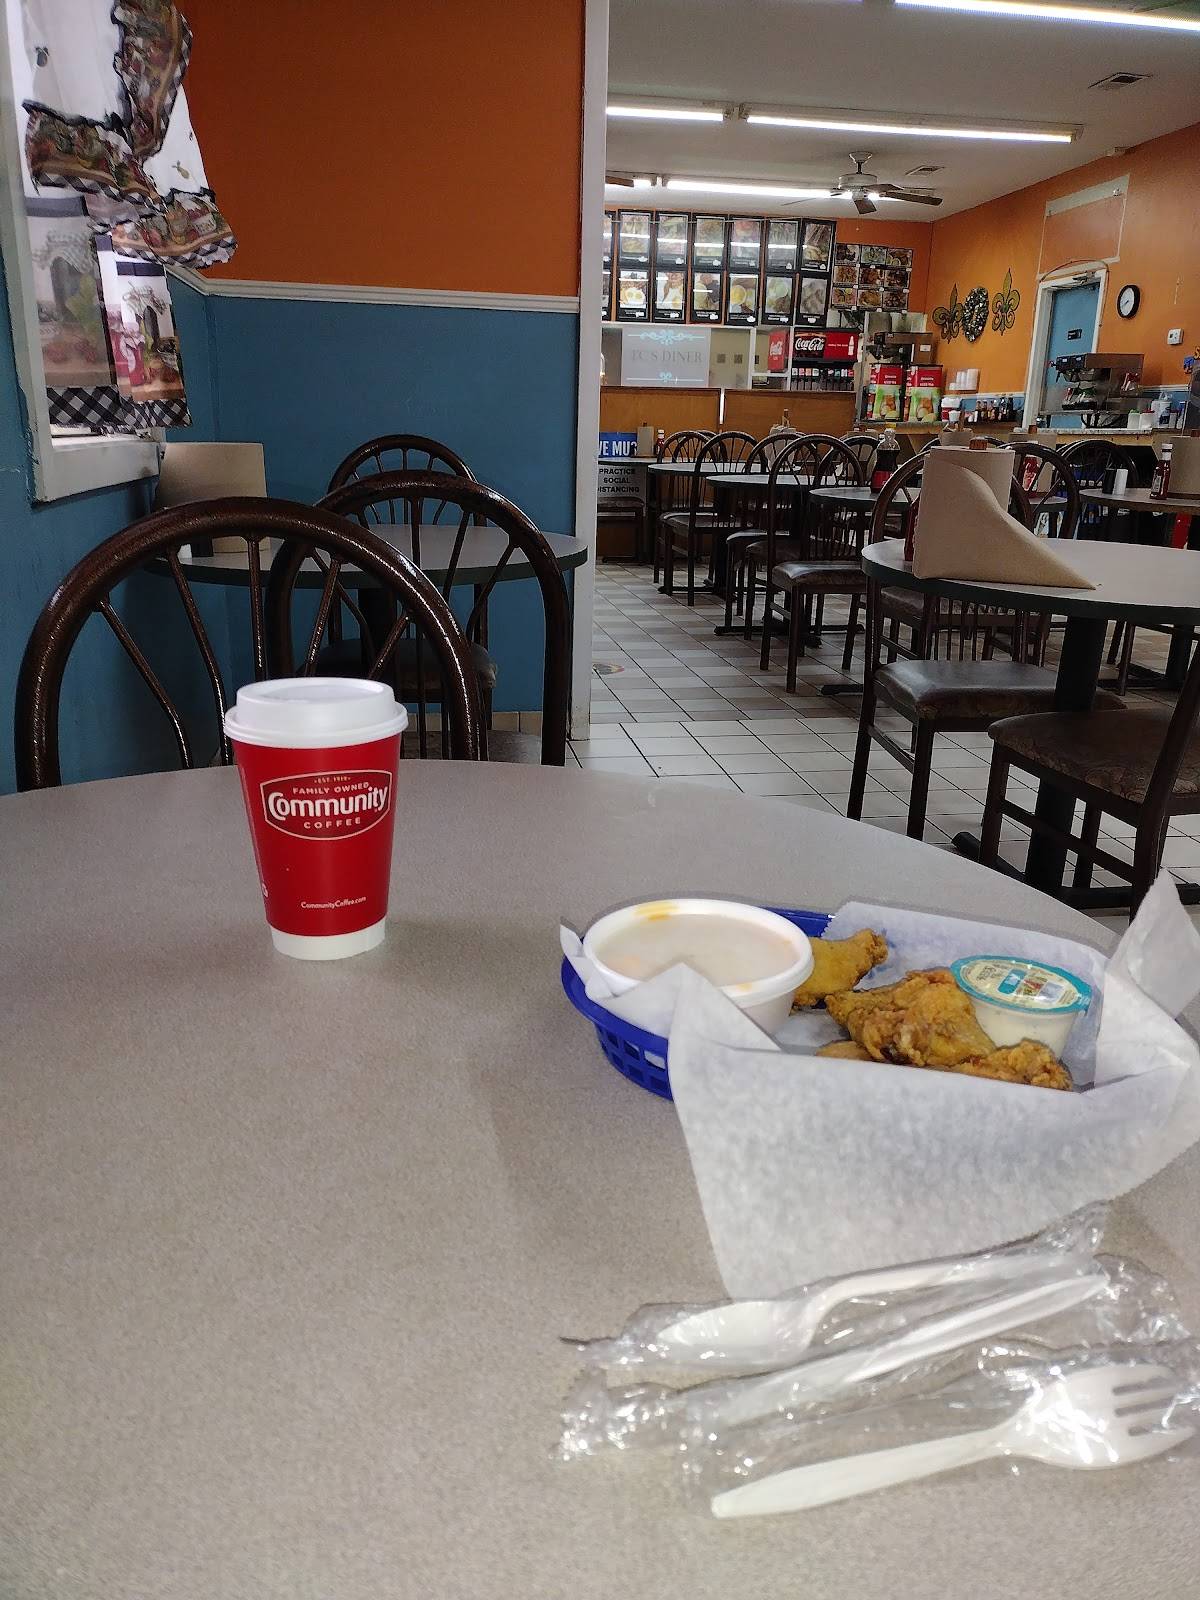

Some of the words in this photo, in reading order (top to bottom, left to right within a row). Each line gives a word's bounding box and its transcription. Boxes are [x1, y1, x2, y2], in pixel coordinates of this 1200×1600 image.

[661, 350, 703, 363] DINER
[292, 785, 330, 795] FAMILY
[334, 781, 370, 793] OWNED
[267, 785, 388, 821] Community
[302, 816, 362, 830] COFFEE
[300, 896, 367, 909] CommunityCoffee.com
